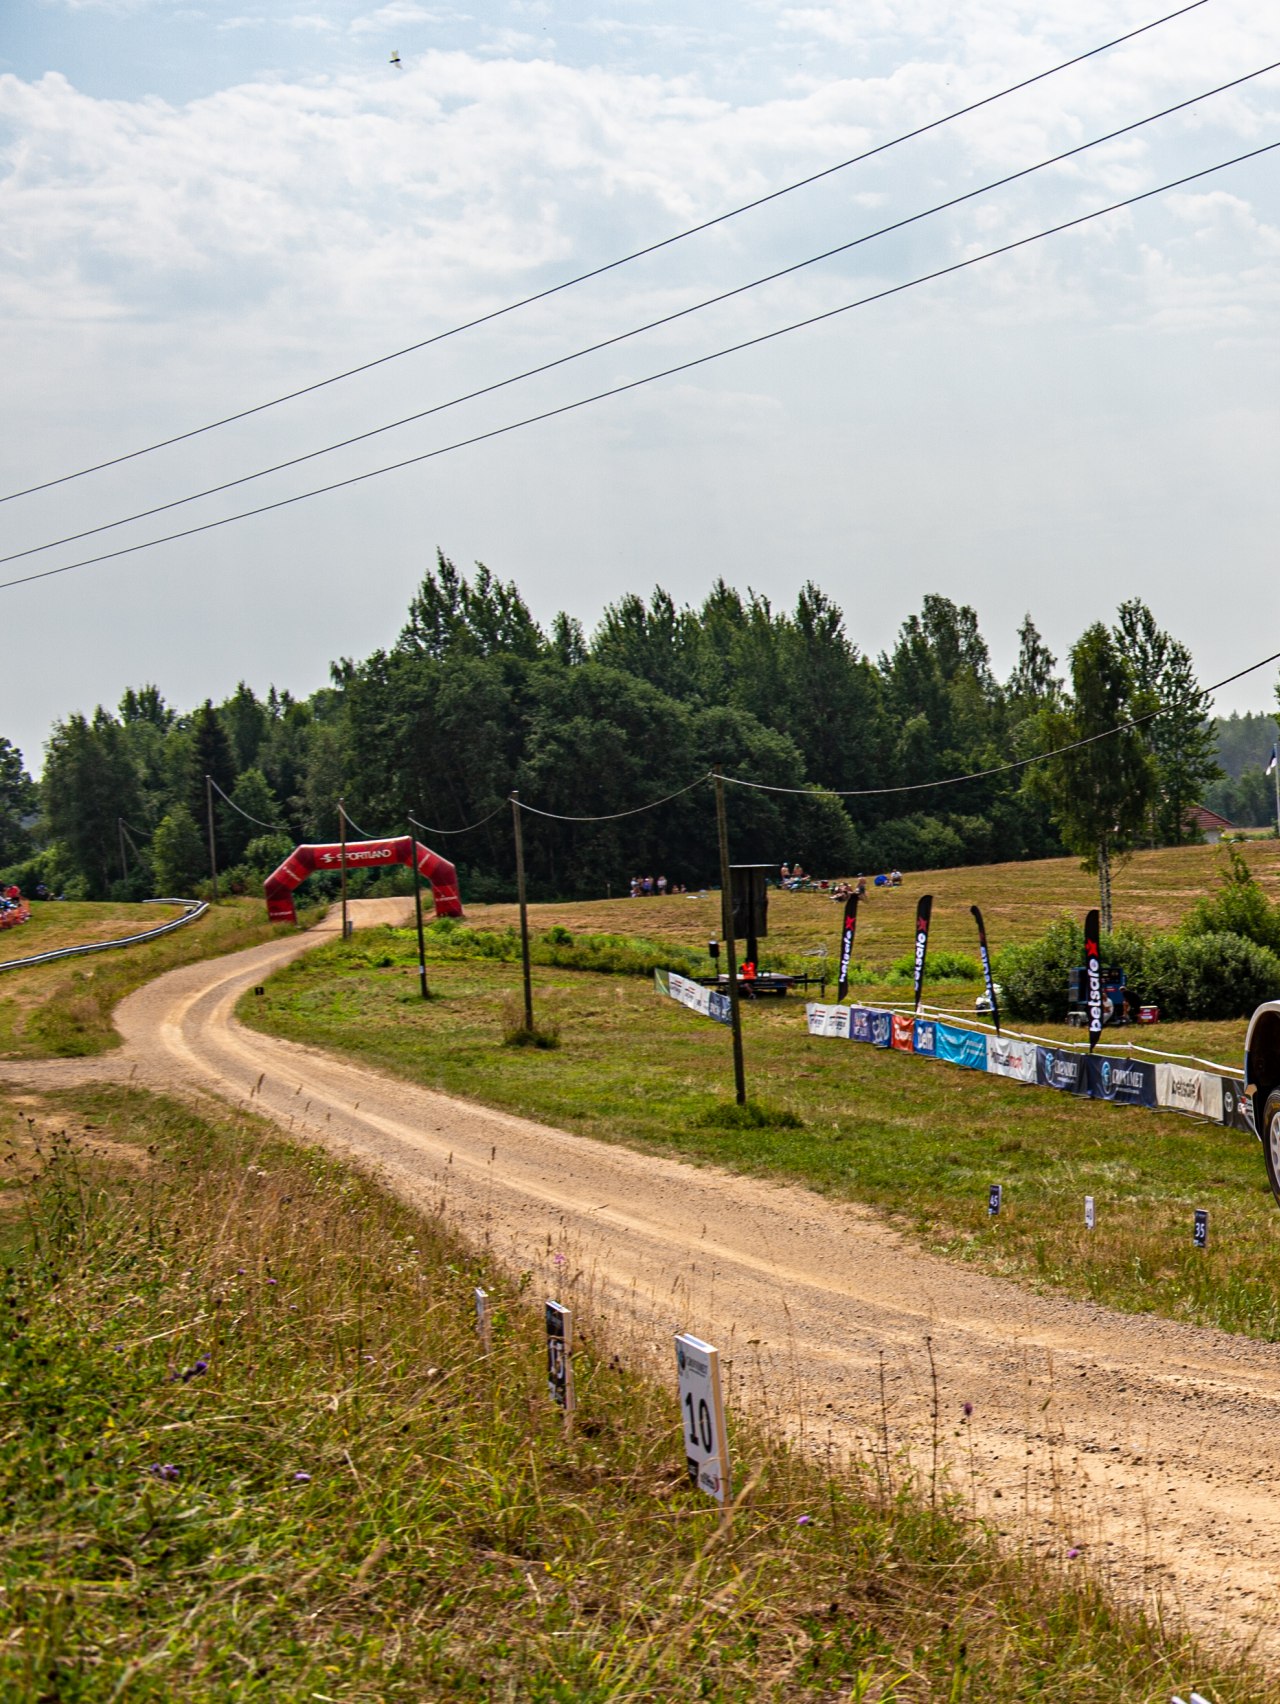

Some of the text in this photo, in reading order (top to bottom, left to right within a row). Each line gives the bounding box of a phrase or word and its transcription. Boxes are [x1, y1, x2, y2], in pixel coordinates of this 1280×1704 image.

[1088, 958, 1102, 1032] betsafe
[1195, 1222, 1205, 1238] 35
[685, 1392, 713, 1454] 10
